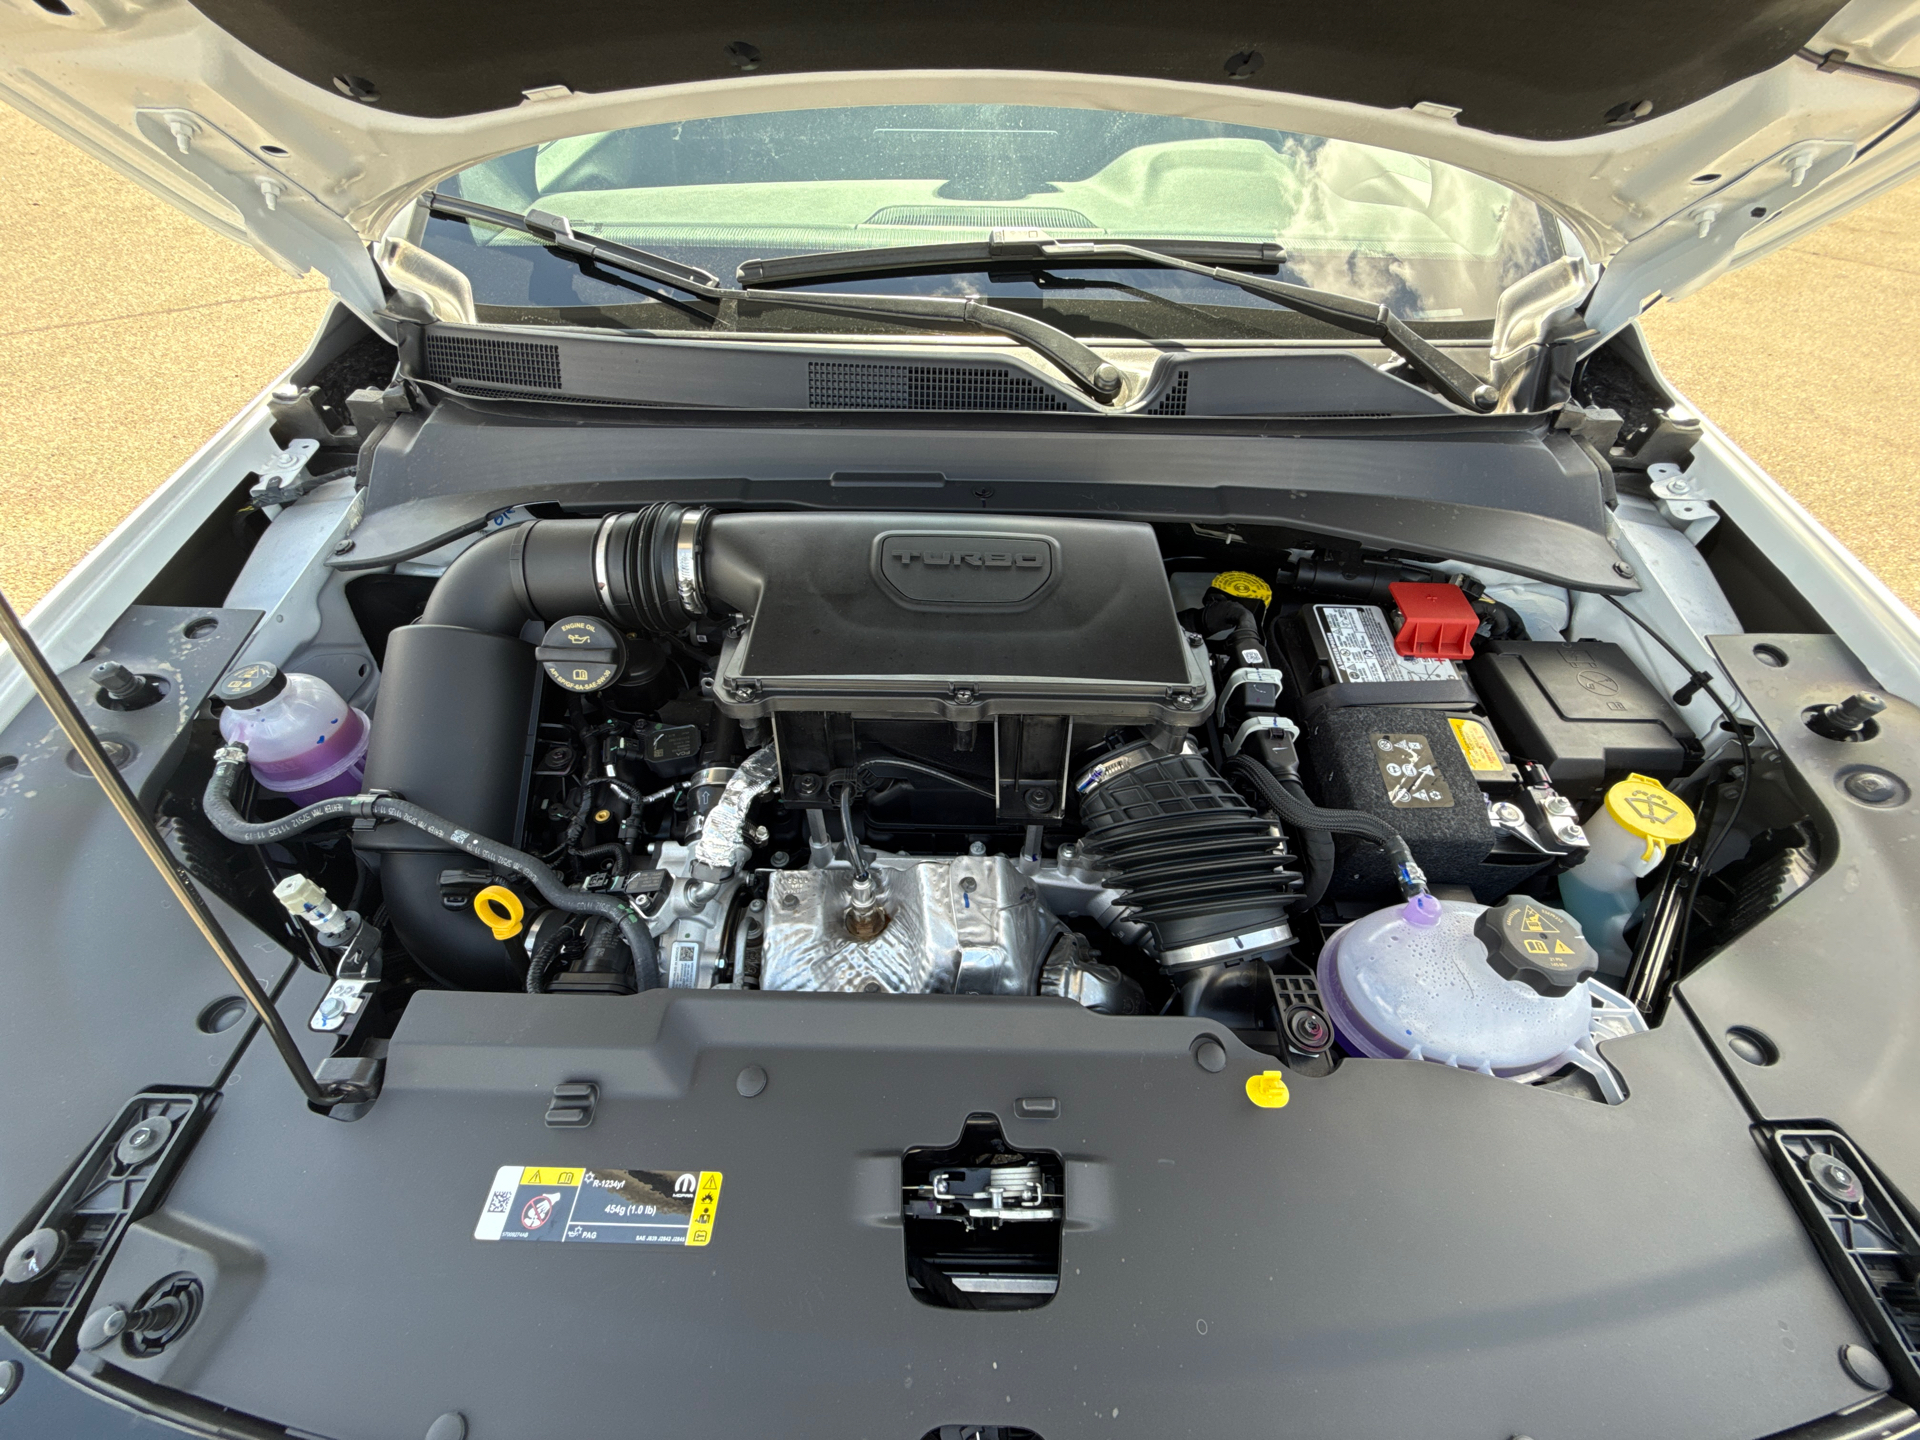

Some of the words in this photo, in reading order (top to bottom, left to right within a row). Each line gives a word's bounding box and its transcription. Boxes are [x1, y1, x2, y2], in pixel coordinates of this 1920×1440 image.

[891, 549, 1044, 568] TURBO
[561, 622, 585, 632] ENGINE
[586, 624, 596, 632] OIL
[549, 668, 558, 678] API
[291, 812, 312, 828] 57512
[268, 824, 290, 836] 11135
[592, 1180, 626, 1190] R-1234yf
[604, 1204, 626, 1216] 454g
[626, 1204, 643, 1216] (1.0
[644, 1205, 657, 1216] lb)
